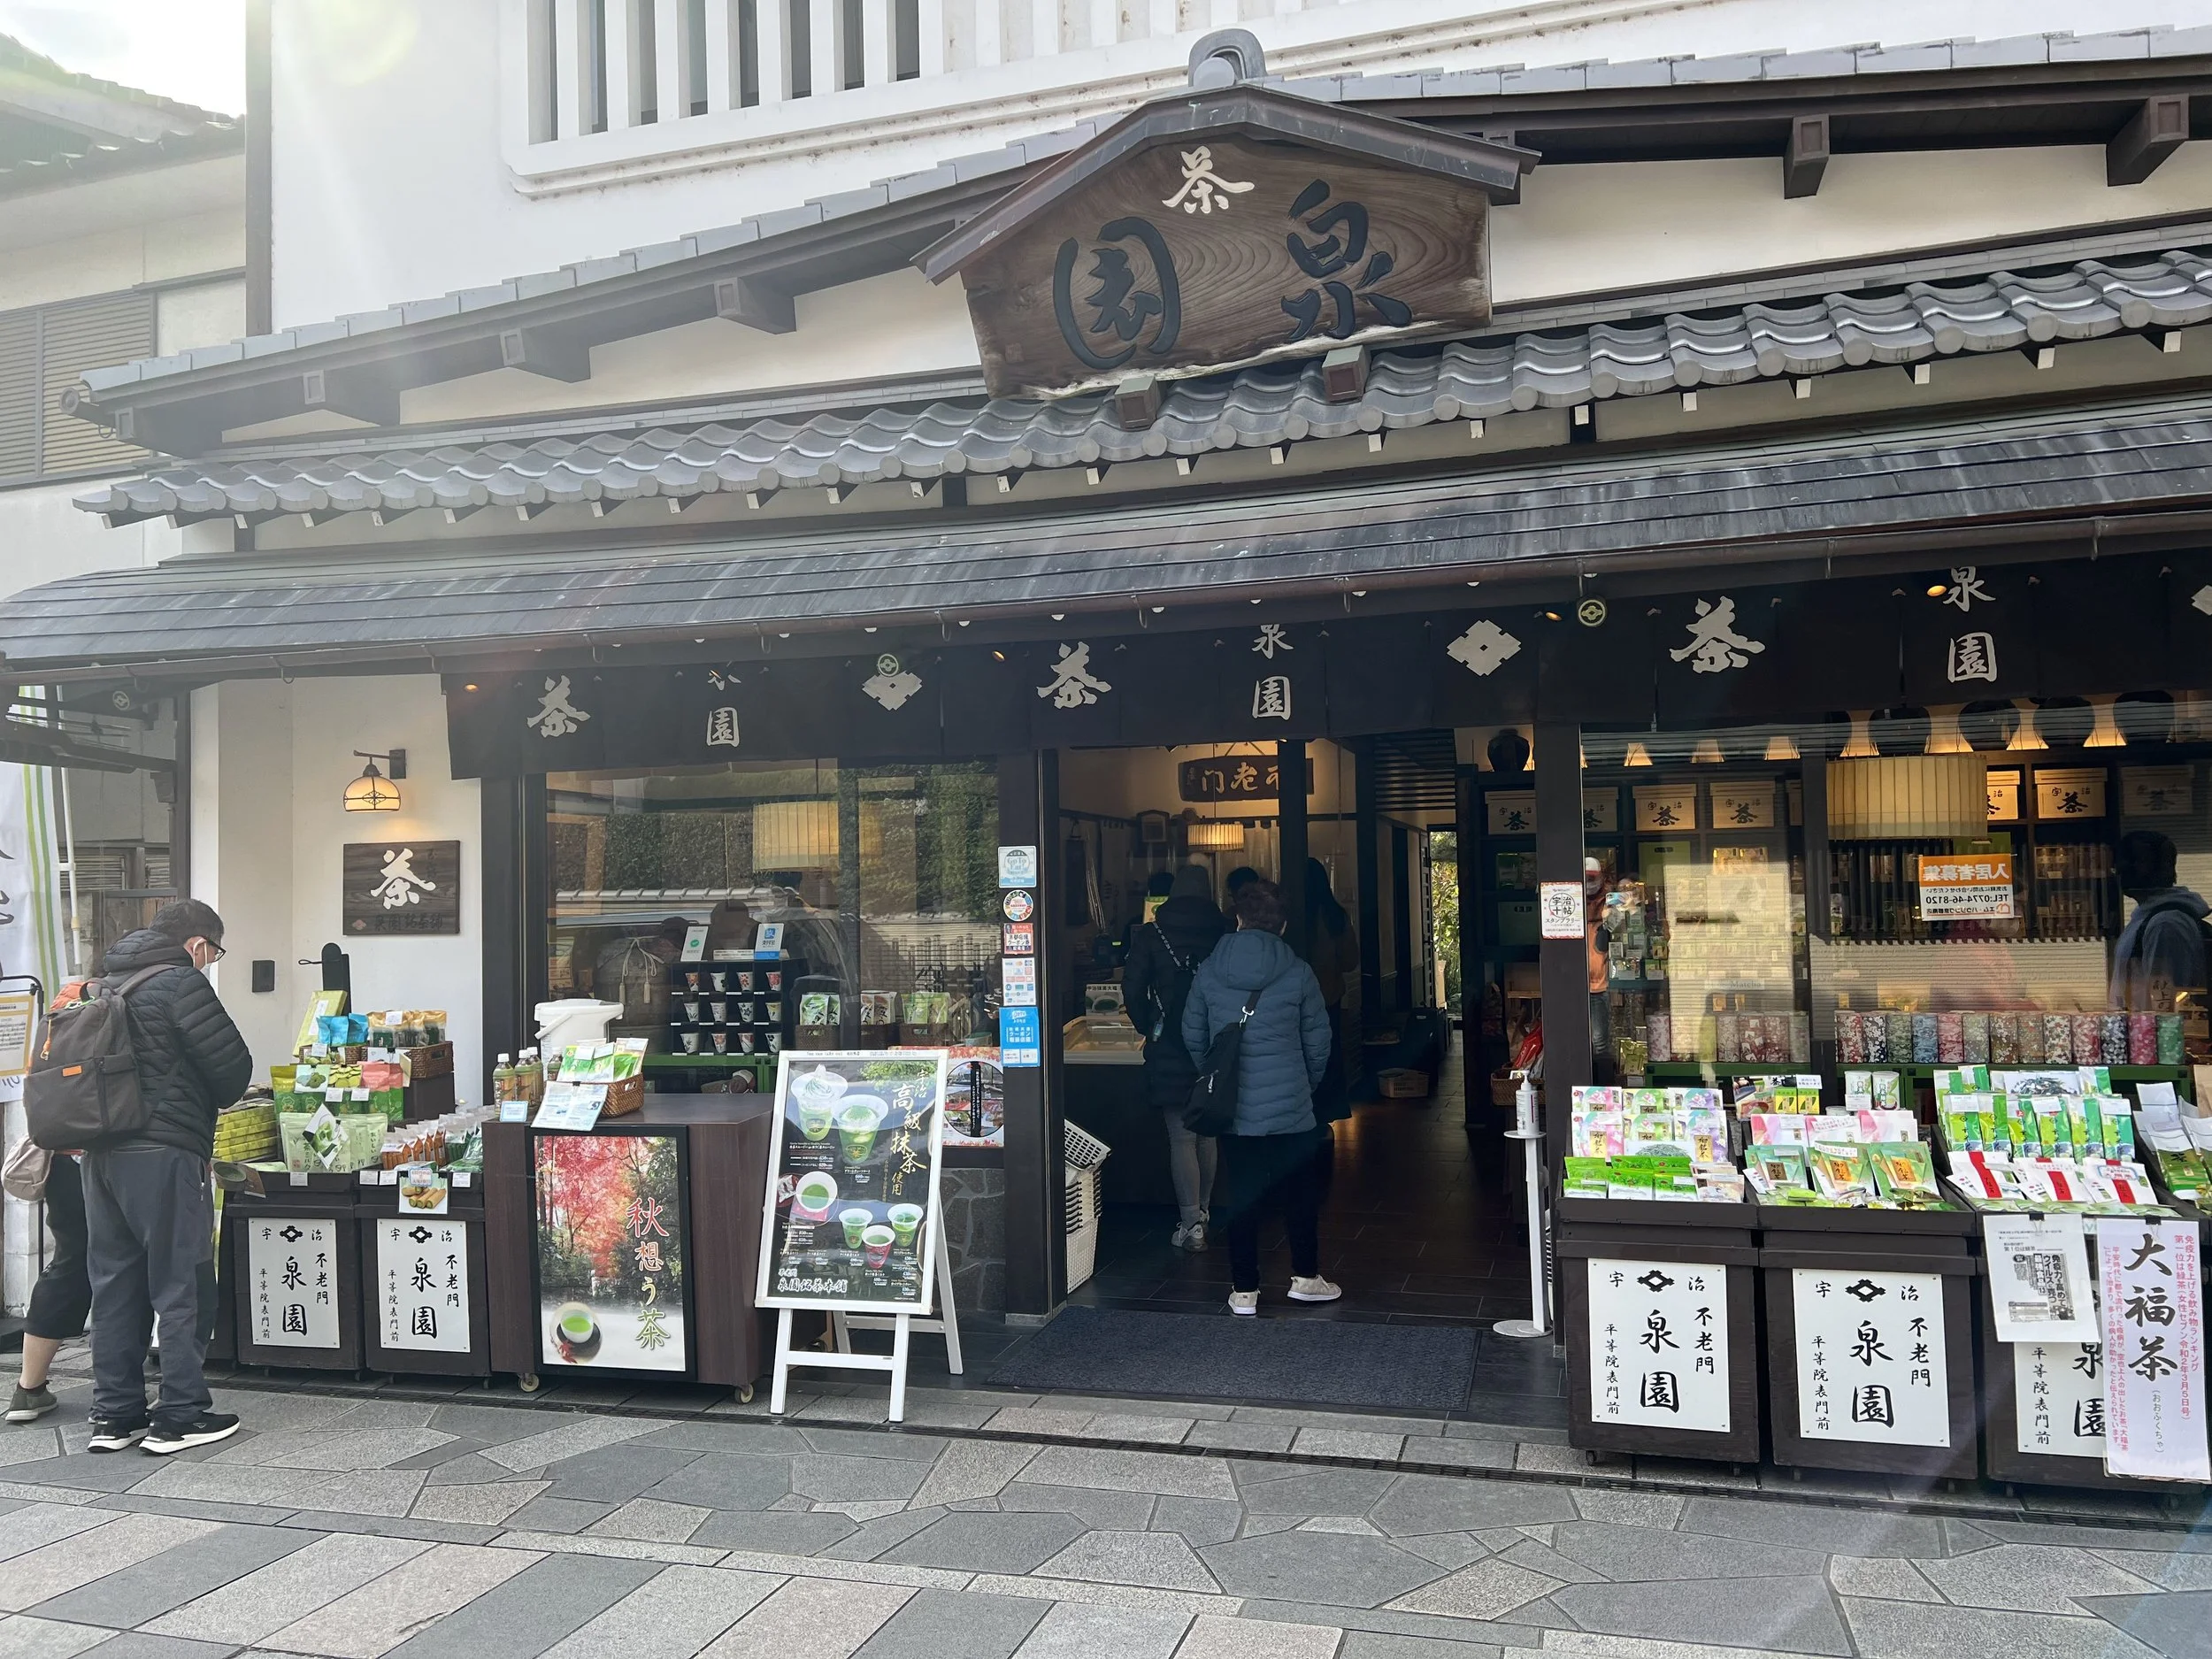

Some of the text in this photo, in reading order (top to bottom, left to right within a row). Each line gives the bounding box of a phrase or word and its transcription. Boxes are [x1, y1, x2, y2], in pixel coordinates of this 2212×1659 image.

[1161, 145, 1255, 214] 茶
[1670, 595, 1765, 674] 茶
[1943, 566, 1997, 683] 泉園
[526, 674, 591, 738] 茶
[1037, 641, 1111, 709] 茶
[1504, 810, 1530, 831] 茶
[1652, 806, 1680, 826] 茶
[1730, 803, 1758, 824] 茶
[2057, 792, 2088, 814] 茶
[371, 848, 436, 910] 茶
[1552, 896, 1571, 905] 宇治
[262, 1227, 322, 1241] 宇 治
[390, 1227, 452, 1242] 宇 治
[259, 1268, 270, 1339] 平等院表門前
[281, 1256, 307, 1336] 泉園
[315, 1253, 328, 1305] 不老門
[388, 1269, 399, 1342] 平等院表門前
[411, 1256, 437, 1339] 泉園
[446, 1254, 459, 1308] 不老門
[626, 1197, 671, 1349] 秋想う茶
[1609, 1271, 1705, 1291] 宇 治
[1816, 1280, 1919, 1301] 宇 治
[2124, 1233, 2177, 1381] 大福茶
[2185, 1235, 2200, 1371] 免疫力を上げる飲み物ランキング
[1604, 1324, 1620, 1415] 平等院表門前
[1640, 1310, 1680, 1413] 泉園
[1694, 1307, 1714, 1375] 不老門
[1849, 1320, 1894, 1428] 泉園
[1908, 1317, 1931, 1387] 不老門
[1811, 1335, 1831, 1430] 平等院表門前
[2032, 1348, 2051, 1445] 平等院表門前
